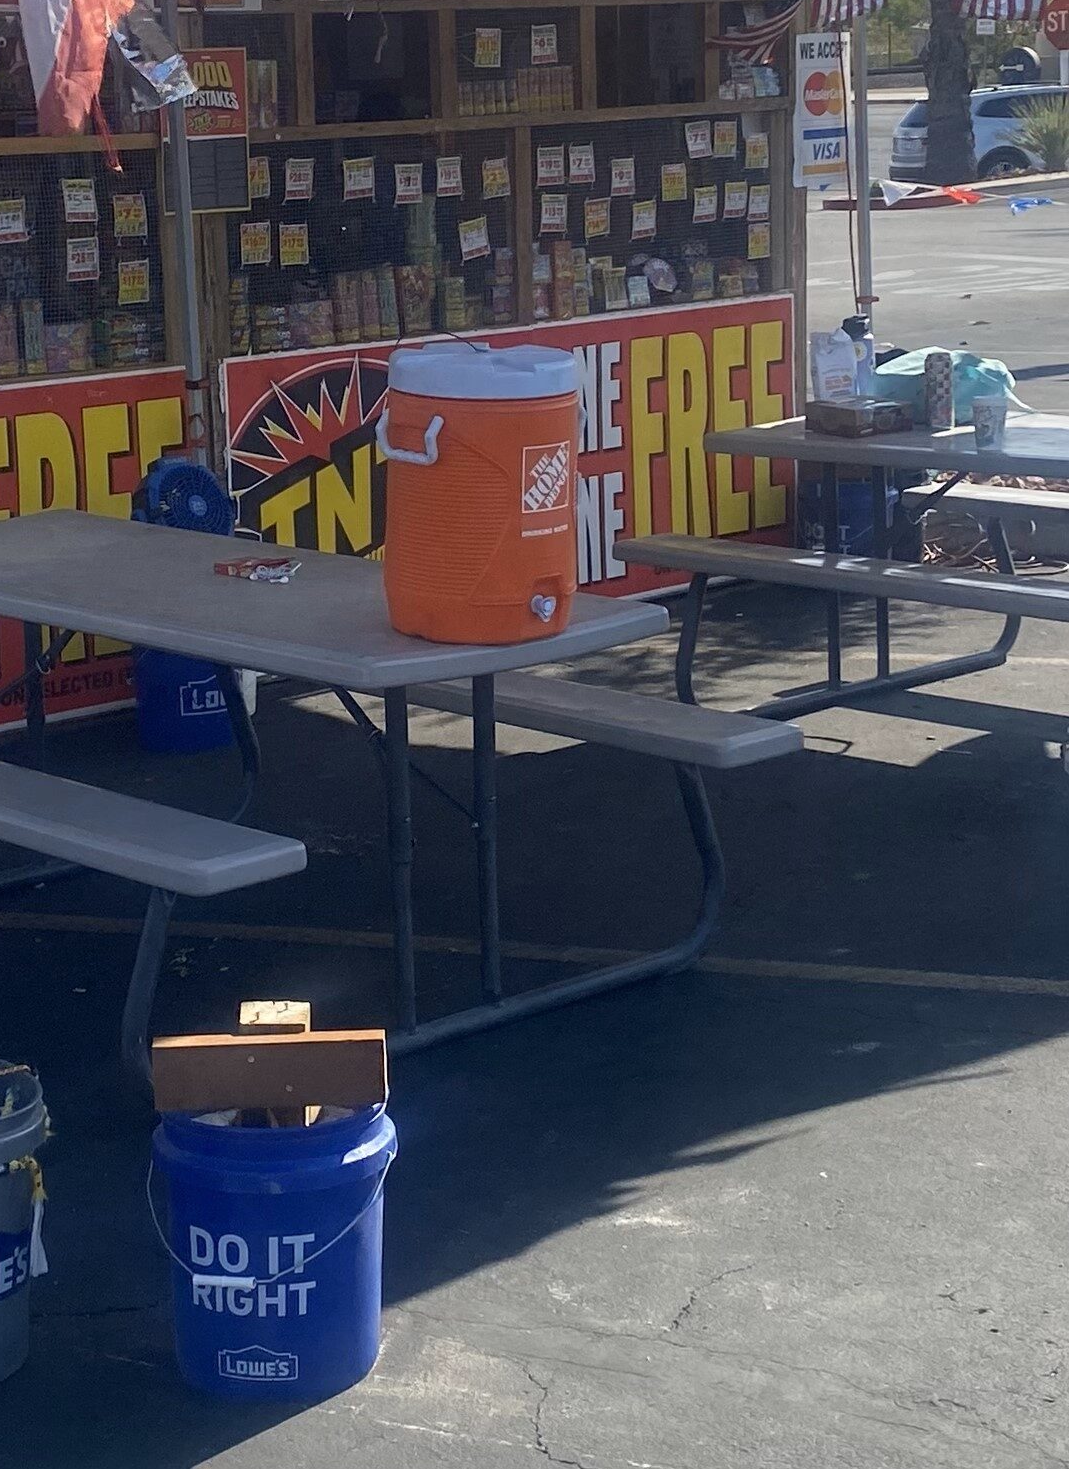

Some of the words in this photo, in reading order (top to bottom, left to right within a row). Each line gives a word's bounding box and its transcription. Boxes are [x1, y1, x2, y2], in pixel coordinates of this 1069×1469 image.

[1047, 10, 1069, 32] ST
[799, 42, 815, 60] WE
[182, 89, 239, 110] EEPSTAKES
[805, 86, 843, 101] MasterCar
[813, 141, 841, 161] VISA
[573, 341, 622, 455] NE
[631, 321, 786, 539] FREE
[523, 443, 568, 511] HOME
[260, 440, 388, 554] TN
[577, 471, 627, 585] NE
[44, 670, 113, 697] ELECTED
[189, 1224, 249, 1274] DO
[268, 1233, 315, 1275] IT
[191, 1278, 317, 1319] RIGHT
[225, 1357, 291, 1378] LOWE'S
